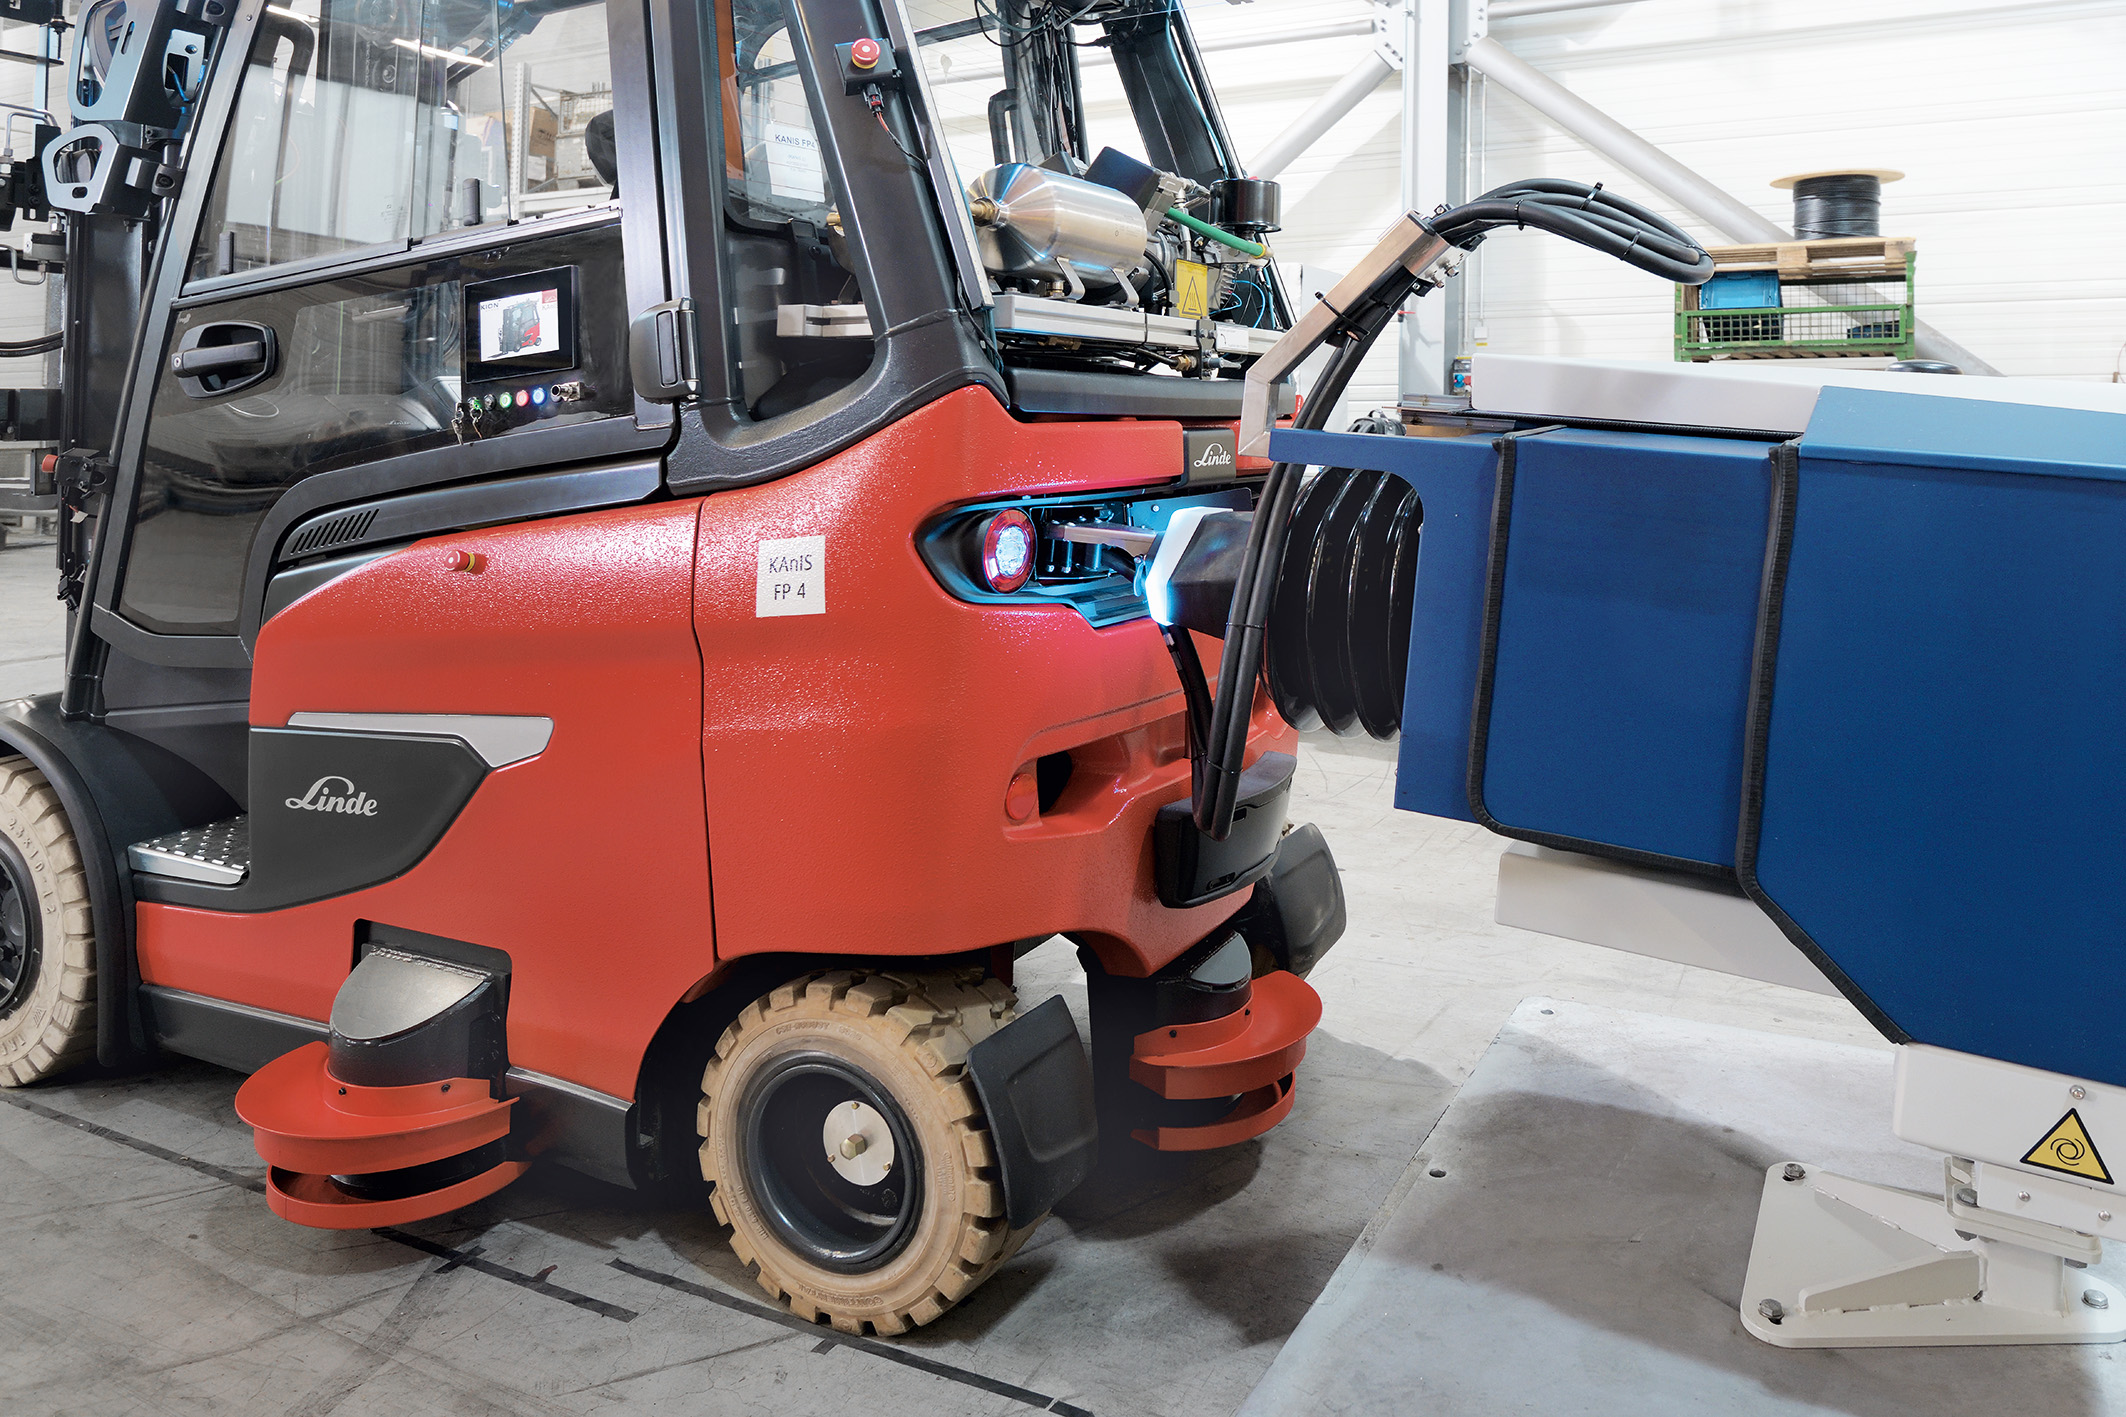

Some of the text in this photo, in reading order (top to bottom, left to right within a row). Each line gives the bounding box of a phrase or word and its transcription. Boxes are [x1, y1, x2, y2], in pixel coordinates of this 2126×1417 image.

[774, 134, 800, 146] KANIS
[1193, 442, 1232, 468] Linde
[774, 582, 806, 600] FP 4
[285, 775, 378, 816] Linde
